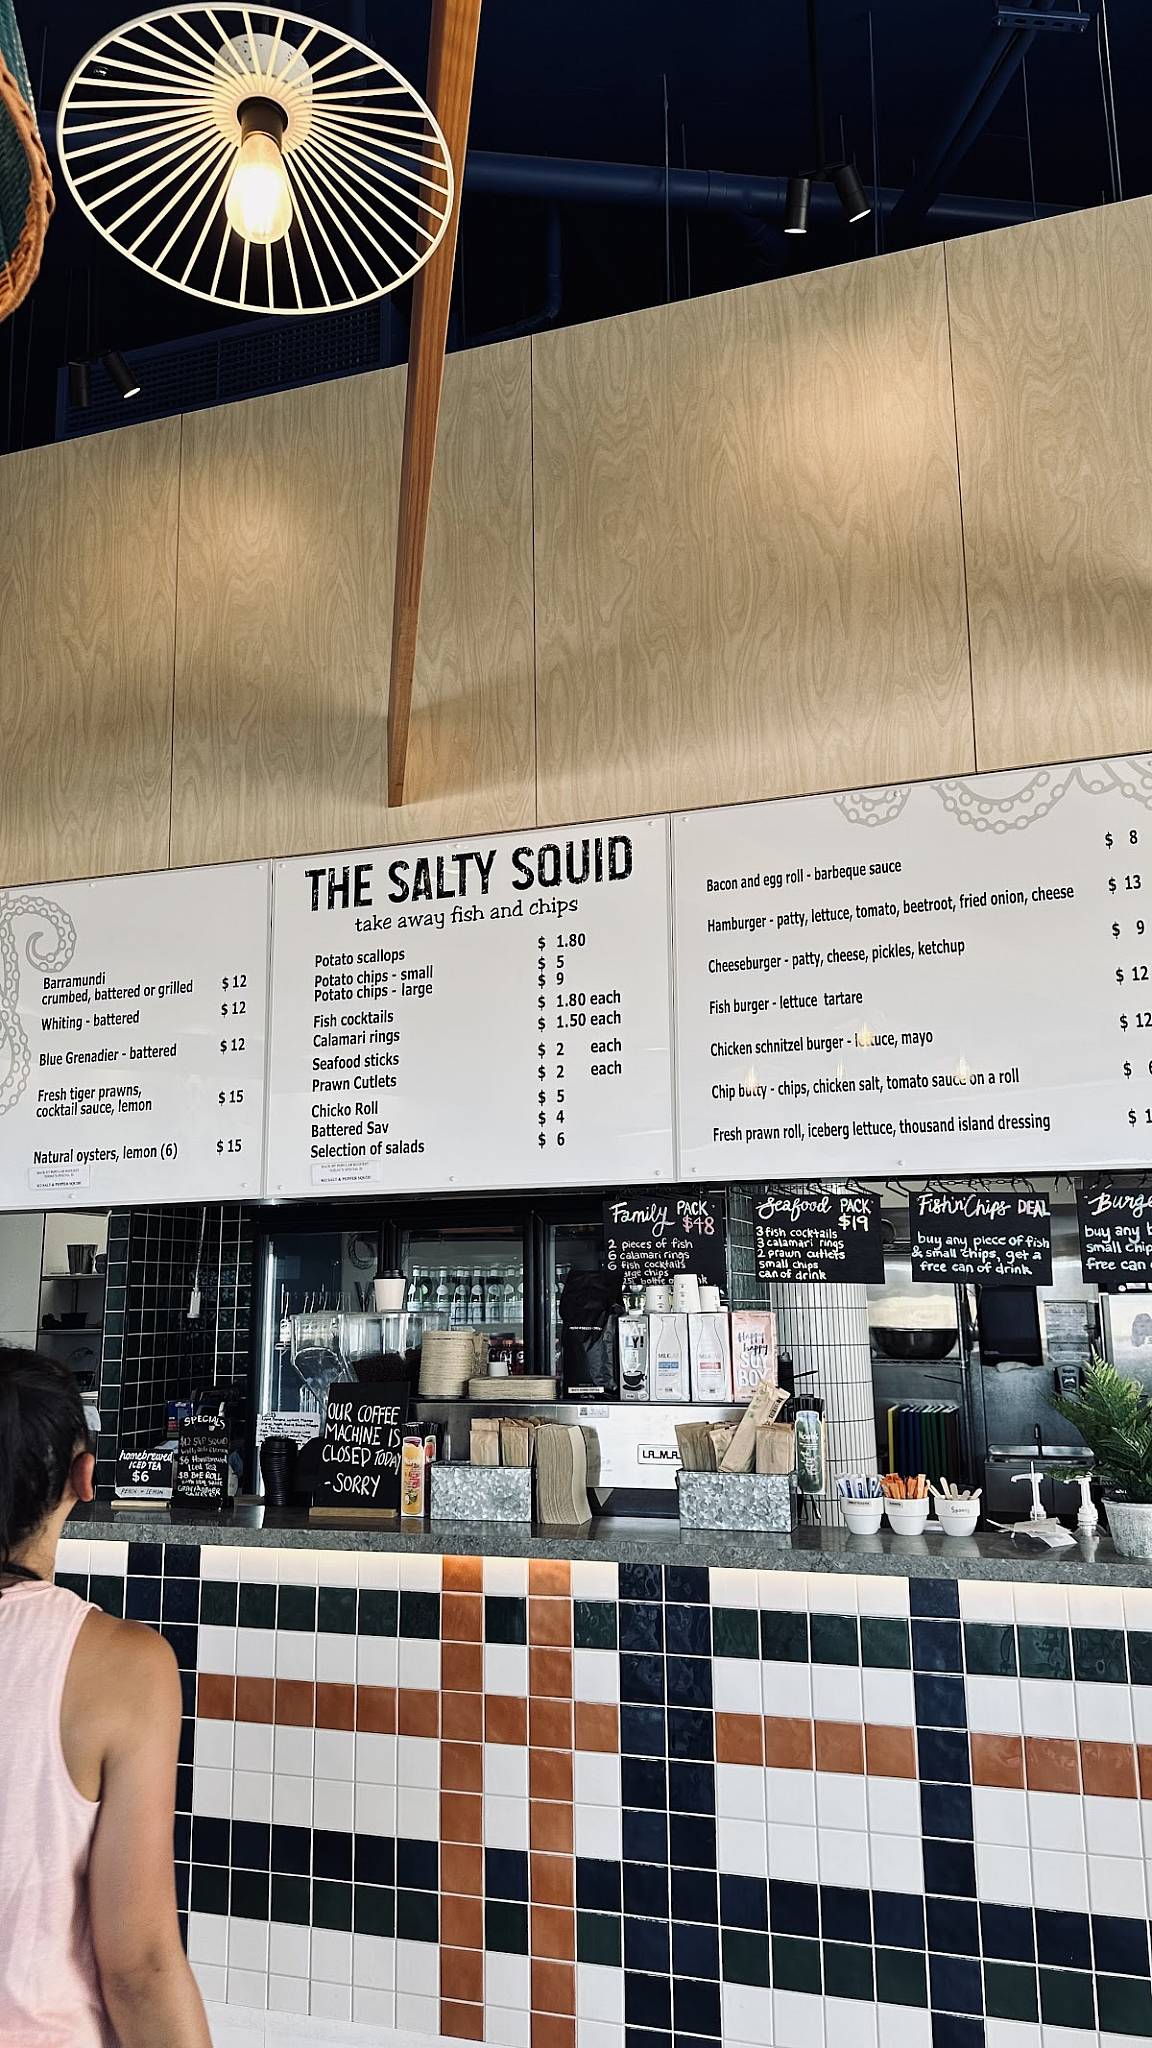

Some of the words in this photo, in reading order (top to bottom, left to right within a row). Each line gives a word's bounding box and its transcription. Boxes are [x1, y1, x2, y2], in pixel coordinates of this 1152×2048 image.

[304, 863, 374, 912] THE
[387, 849, 497, 904] SALTY
[511, 835, 633, 891] SQUID
[706, 878, 738, 893] Bacon
[740, 873, 761, 889] and
[763, 874, 783, 889] egg
[785, 868, 804, 885] roll
[814, 864, 867, 881] barbeque
[869, 861, 902, 876] sauce
[354, 914, 392, 933] take
[397, 912, 445, 930] away
[449, 904, 485, 924] fish
[489, 899, 524, 920] and
[529, 896, 578, 919] chips
[707, 916, 767, 933] Hamburger
[776, 911, 809, 930] patty,
[811, 908, 853, 923] lettuce,
[855, 901, 900, 919] tomato,
[903, 895, 957, 914] beetroot,
[959, 891, 987, 909] fried
[990, 889, 1028, 906] onion,
[1031, 886, 1075, 902] cheese
[556, 932, 586, 948] 1.80
[314, 952, 354, 968] Potato
[356, 948, 406, 965] scallops
[708, 955, 782, 974] Cheeseburger
[792, 951, 824, 970] patty,
[826, 948, 869, 964] cheese,
[871, 943, 915, 963] pickles,
[917, 938, 965, 957] ketchup
[43, 971, 106, 990] Barramundi
[314, 972, 354, 988] Potato
[356, 969, 389, 986] chips
[400, 964, 433, 981] small
[41, 988, 91, 1006] crumbed,
[94, 983, 141, 1001] battered
[143, 986, 156, 997] or
[157, 979, 193, 999] grilled
[314, 987, 354, 1003] Potato
[356, 983, 389, 1001] chips
[401, 982, 433, 999] large
[556, 992, 586, 1008] 1.80
[589, 989, 621, 1006] each
[709, 999, 731, 1015] Fish
[733, 998, 770, 1015] burger
[779, 994, 818, 1010] lettuce
[823, 991, 863, 1007] tartare
[41, 1015, 83, 1032] Whiting
[93, 1009, 140, 1027] battered
[313, 1013, 337, 1029] Fish
[340, 1009, 394, 1027] cocktails
[556, 1012, 587, 1029] 1.50
[590, 1009, 622, 1026] each
[313, 1030, 366, 1048] Calamari
[369, 1029, 401, 1046] rings
[590, 1037, 622, 1054] each
[710, 1041, 753, 1058] Chicken
[755, 1036, 804, 1054] schnitzel
[806, 1036, 844, 1053] burger
[901, 1031, 934, 1048] mayo
[39, 1052, 63, 1067] Blue
[65, 1048, 120, 1065] Grenadier
[129, 1042, 177, 1060] battered
[312, 1053, 361, 1071] Seafood
[364, 1051, 400, 1068] sticks
[590, 1059, 622, 1076] each
[312, 1078, 350, 1093] Prawn
[353, 1074, 397, 1090] Cutlets
[711, 1083, 736, 1102] Chip
[777, 1079, 810, 1099] chips,
[812, 1077, 856, 1094] chicken
[858, 1075, 884, 1094] salt,
[886, 1073, 929, 1090] tomato
[969, 1073, 985, 1086] on
[988, 1072, 996, 1085] a
[998, 1067, 1020, 1084] roll
[37, 1087, 67, 1103] Fresh
[69, 1086, 96, 1103] tiger
[98, 1085, 142, 1102] prawns,
[35, 1101, 78, 1118] cocktail
[80, 1102, 115, 1116] sauce,
[118, 1098, 152, 1113] lemon
[311, 1102, 352, 1118] Chicko
[355, 1100, 378, 1116] Roll
[311, 1120, 363, 1138] Battered
[366, 1120, 389, 1135] Sav
[713, 1126, 743, 1142] Fresh
[745, 1127, 780, 1144] prawn
[783, 1123, 805, 1142] roll,
[807, 1122, 850, 1140] iceberg
[852, 1120, 897, 1138] lettuce,
[898, 1116, 955, 1134] thousand
[957, 1114, 995, 1132] island
[997, 1112, 1051, 1132] dressing
[33, 1148, 74, 1165] Natural
[76, 1147, 120, 1165] oysters,
[122, 1145, 158, 1160] lemon
[160, 1142, 178, 1161] (6)
[310, 1142, 366, 1159] Selection
[369, 1140, 383, 1156] of
[385, 1138, 425, 1155] salads
[609, 1202, 675, 1237] Family
[677, 1200, 709, 1216] PACK
[755, 1196, 832, 1222] Seafood
[839, 1198, 872, 1214] PACK
[1017, 1199, 1051, 1218] DEAL
[682, 1215, 715, 1235] $48
[838, 1212, 869, 1232] $19
[765, 1226, 786, 1238] fish
[790, 1227, 838, 1239] cocktails
[917, 1230, 942, 1251] buy
[945, 1236, 968, 1251] any
[973, 1236, 1006, 1251] piece
[1025, 1235, 1050, 1249] fish
[1084, 1224, 1111, 1244] buy
[1115, 1226, 1141, 1244] any
[621, 1240, 652, 1251] pieces
[671, 1238, 693, 1249] fish
[766, 1238, 814, 1248] calamari
[819, 1239, 845, 1252] rings
[767, 1249, 802, 1259] prawn
[1086, 1240, 1122, 1253] small
[620, 1251, 661, 1260] calamari
[644, 1260, 686, 1270] cocktails
[759, 1259, 789, 1269] small
[792, 1260, 819, 1272] chips
[925, 1248, 957, 1258] small
[1005, 1249, 1030, 1264] get
[1086, 1257, 1117, 1270] free
[1120, 1260, 1146, 1271] can
[758, 1270, 779, 1279] can
[795, 1269, 827, 1280] drink
[920, 1260, 947, 1273] free
[951, 1262, 974, 1273] can
[995, 1263, 1033, 1275] drink
[184, 1415, 226, 1430] SPECIALS
[328, 1402, 352, 1423] OUR
[357, 1405, 401, 1425] COFFEE
[324, 1423, 382, 1446] MACHINE
[388, 1428, 401, 1448] IS
[119, 1450, 173, 1463] homebrewed
[128, 1461, 147, 1470] ICED
[322, 1444, 372, 1468] CLOSED
[374, 1449, 402, 1475] TODAY
[132, 1470, 149, 1483] $6
